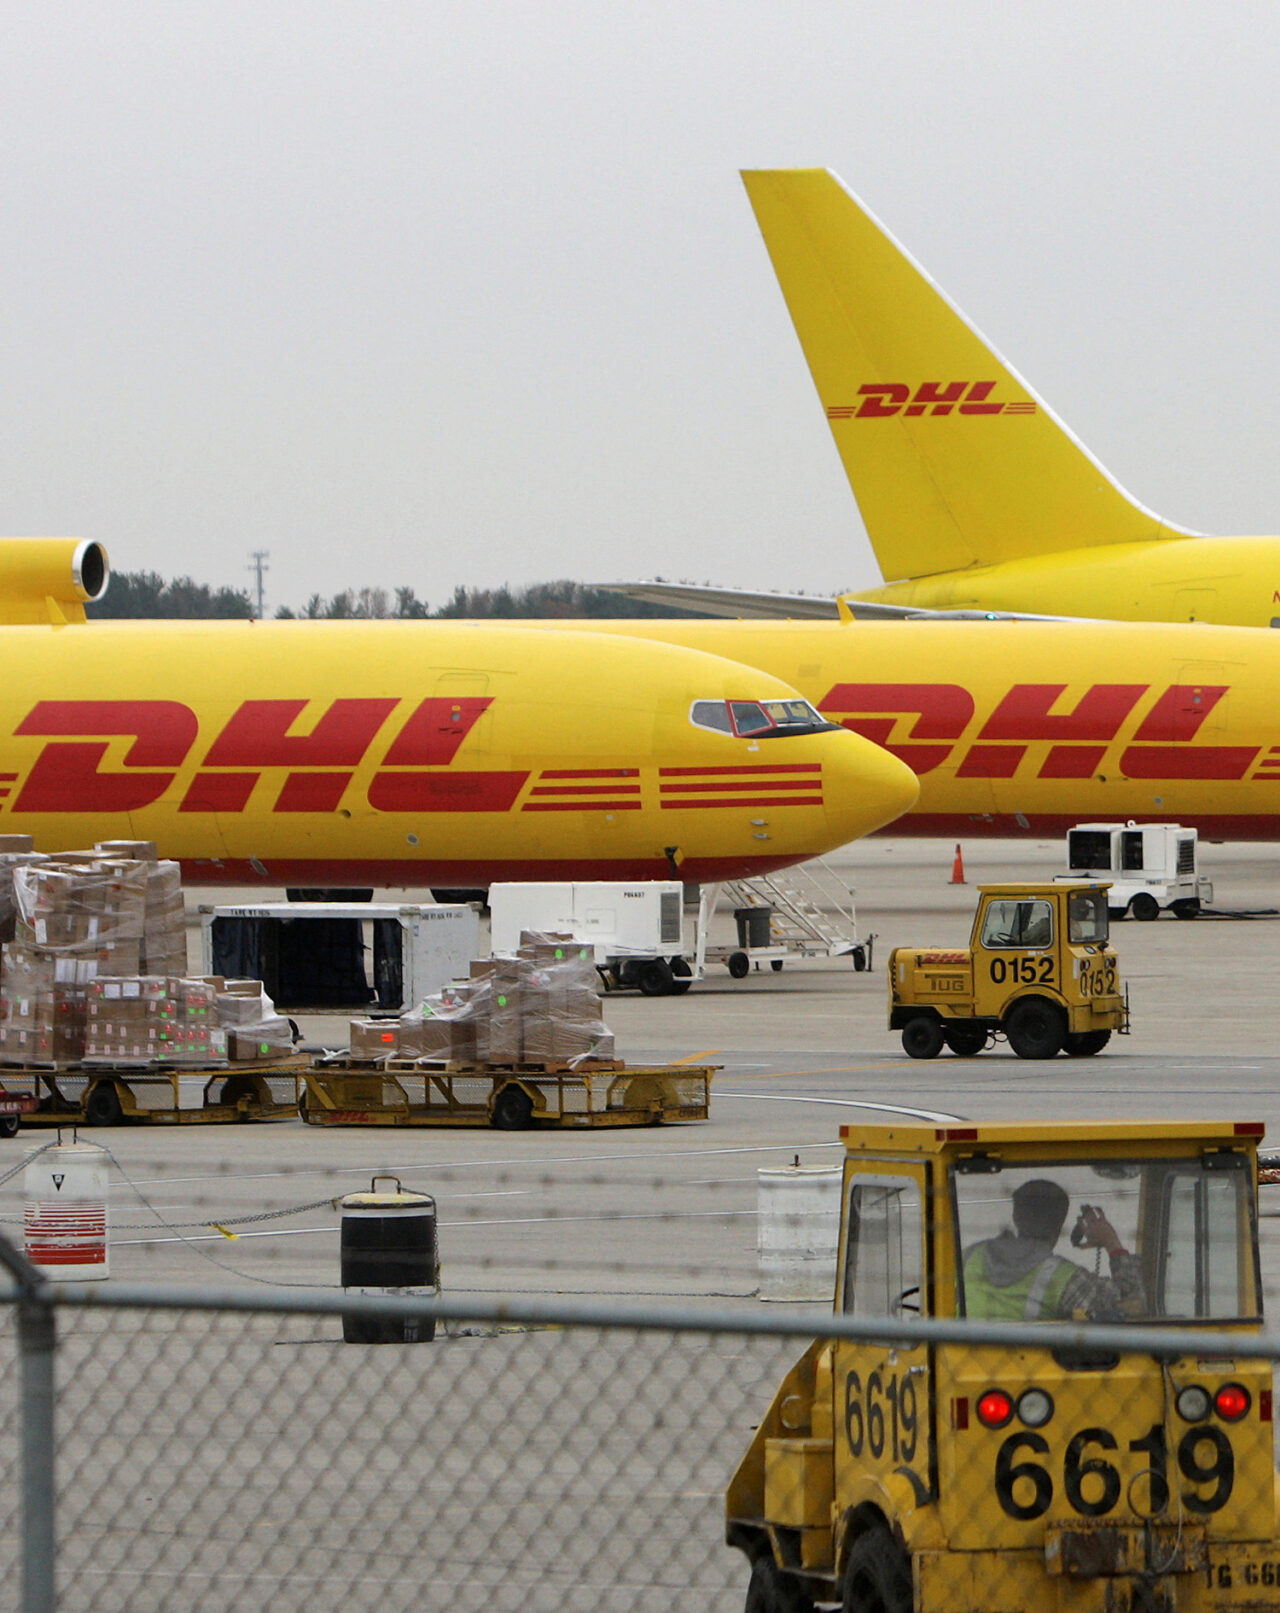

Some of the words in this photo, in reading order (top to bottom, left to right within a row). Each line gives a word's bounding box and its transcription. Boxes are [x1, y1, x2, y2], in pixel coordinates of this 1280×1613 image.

[855, 381, 1005, 418] DHL
[817, 684, 1262, 780] DHL
[11, 697, 530, 813] DHL
[922, 953, 968, 964] DHL
[990, 957, 1055, 984] 0152
[924, 973, 965, 992] TUG
[1079, 969, 1116, 998] 0152
[845, 1369, 918, 1464] 6619
[994, 1423, 1235, 1522] 6619
